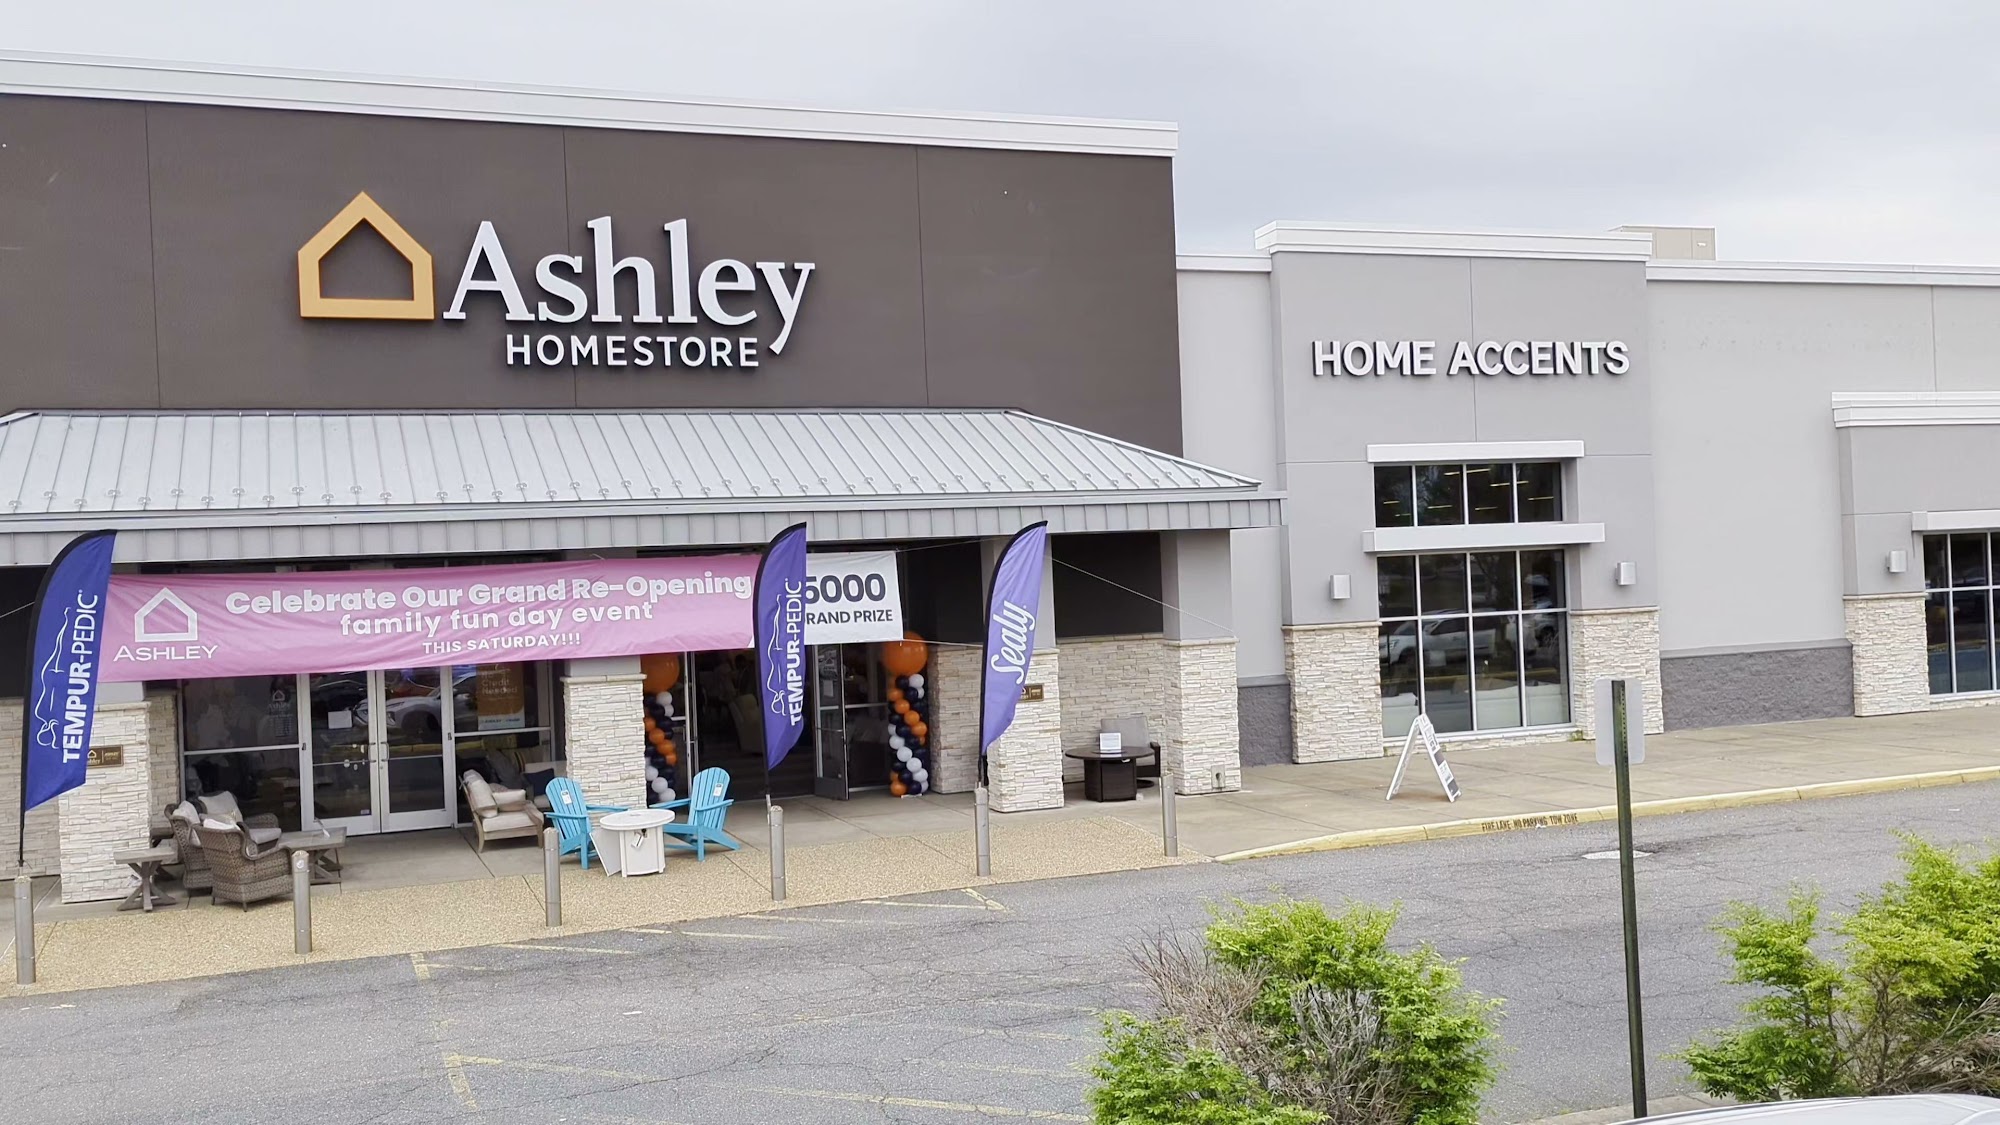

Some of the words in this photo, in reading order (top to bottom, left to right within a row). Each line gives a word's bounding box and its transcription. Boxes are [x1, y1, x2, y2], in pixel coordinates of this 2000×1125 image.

[443, 216, 815, 355] Ashley
[506, 334, 760, 368] HOMESTORE
[1313, 340, 1437, 376] HOME
[1448, 340, 1630, 376] ACCENTS
[225, 587, 397, 614] Celebrate
[402, 585, 463, 607] Our
[469, 579, 566, 606] Grand
[572, 571, 752, 603] Re-Opening
[340, 611, 441, 638] family
[450, 609, 499, 629] fun
[508, 606, 564, 630] day
[572, 601, 653, 623] event
[805, 611, 851, 625] RAND
[853, 609, 893, 623] PRIZE
[113, 645, 218, 662] ASHLEY
[422, 640, 462, 655] THIS
[467, 632, 581, 651] SATURDAY!!!
[785, 580, 804, 727] TEMPUR-PEDIC
[990, 600, 1035, 685] Sealy
[62, 593, 98, 764] TEMPUR-PEDIC
